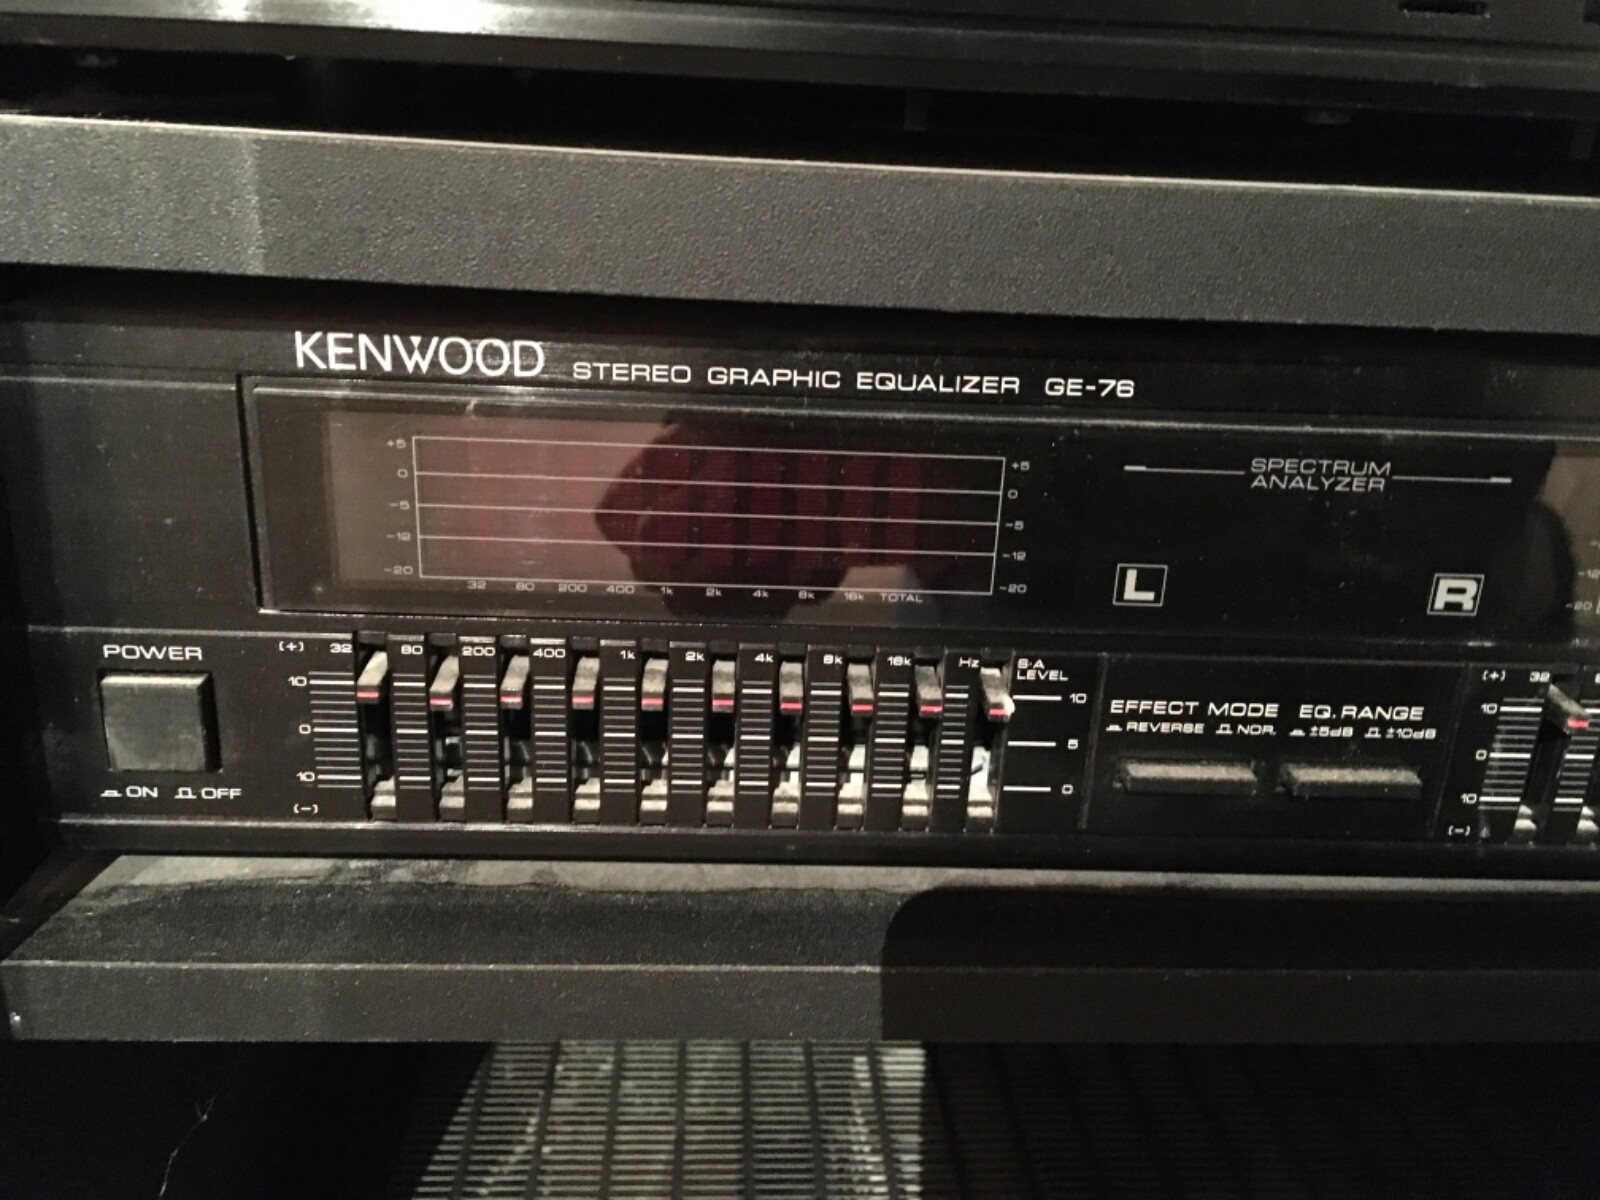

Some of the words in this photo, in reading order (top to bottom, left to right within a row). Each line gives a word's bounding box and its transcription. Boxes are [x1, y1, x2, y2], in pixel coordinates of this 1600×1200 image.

[295, 331, 545, 377] KENWOOD
[572, 361, 691, 385] STEREO
[707, 367, 841, 390] GRAPHIC
[856, 371, 1020, 395] EQUALIZER
[1044, 378, 1135, 398] GE-76
[386, 439, 406, 449] +5
[1011, 461, 1030, 471] +5
[1250, 458, 1391, 476] SPECTRUM
[1251, 475, 1385, 493] ANALYZER
[1008, 490, 1018, 499] 0
[1005, 521, 1024, 531] -5
[1002, 551, 1026, 561] -12
[384, 565, 413, 576] -20
[999, 584, 1027, 594] -20
[1123, 569, 1156, 601] L
[467, 580, 486, 590] 32
[516, 582, 535, 592] 80
[558, 584, 588, 593] 200
[606, 585, 635, 595] 400
[753, 589, 769, 599] 4k
[880, 593, 923, 603] TOTAL
[1433, 578, 1478, 611] R
[103, 644, 203, 661] POWER
[330, 643, 353, 653] 32
[401, 645, 423, 655] 80
[461, 646, 496, 657] 200
[533, 648, 566, 659] 400
[619, 650, 636, 660] 1k
[685, 651, 705, 662] 2k
[754, 653, 773, 663] 4k
[823, 654, 843, 665] 8k
[959, 657, 980, 668] Hz
[288, 676, 307, 687] 10
[1016, 669, 1069, 682] LEVEL
[1069, 693, 1087, 704] 10
[1110, 699, 1199, 715] EFFECT
[1207, 702, 1280, 717] MODE
[1481, 703, 1498, 714] 10
[299, 724, 311, 735] 0
[1126, 722, 1205, 734] REVERSE
[1475, 749, 1487, 761] 0
[296, 772, 315, 782] 10
[126, 785, 158, 798] ON
[201, 788, 242, 800] OFF
[1461, 793, 1477, 804] 10
